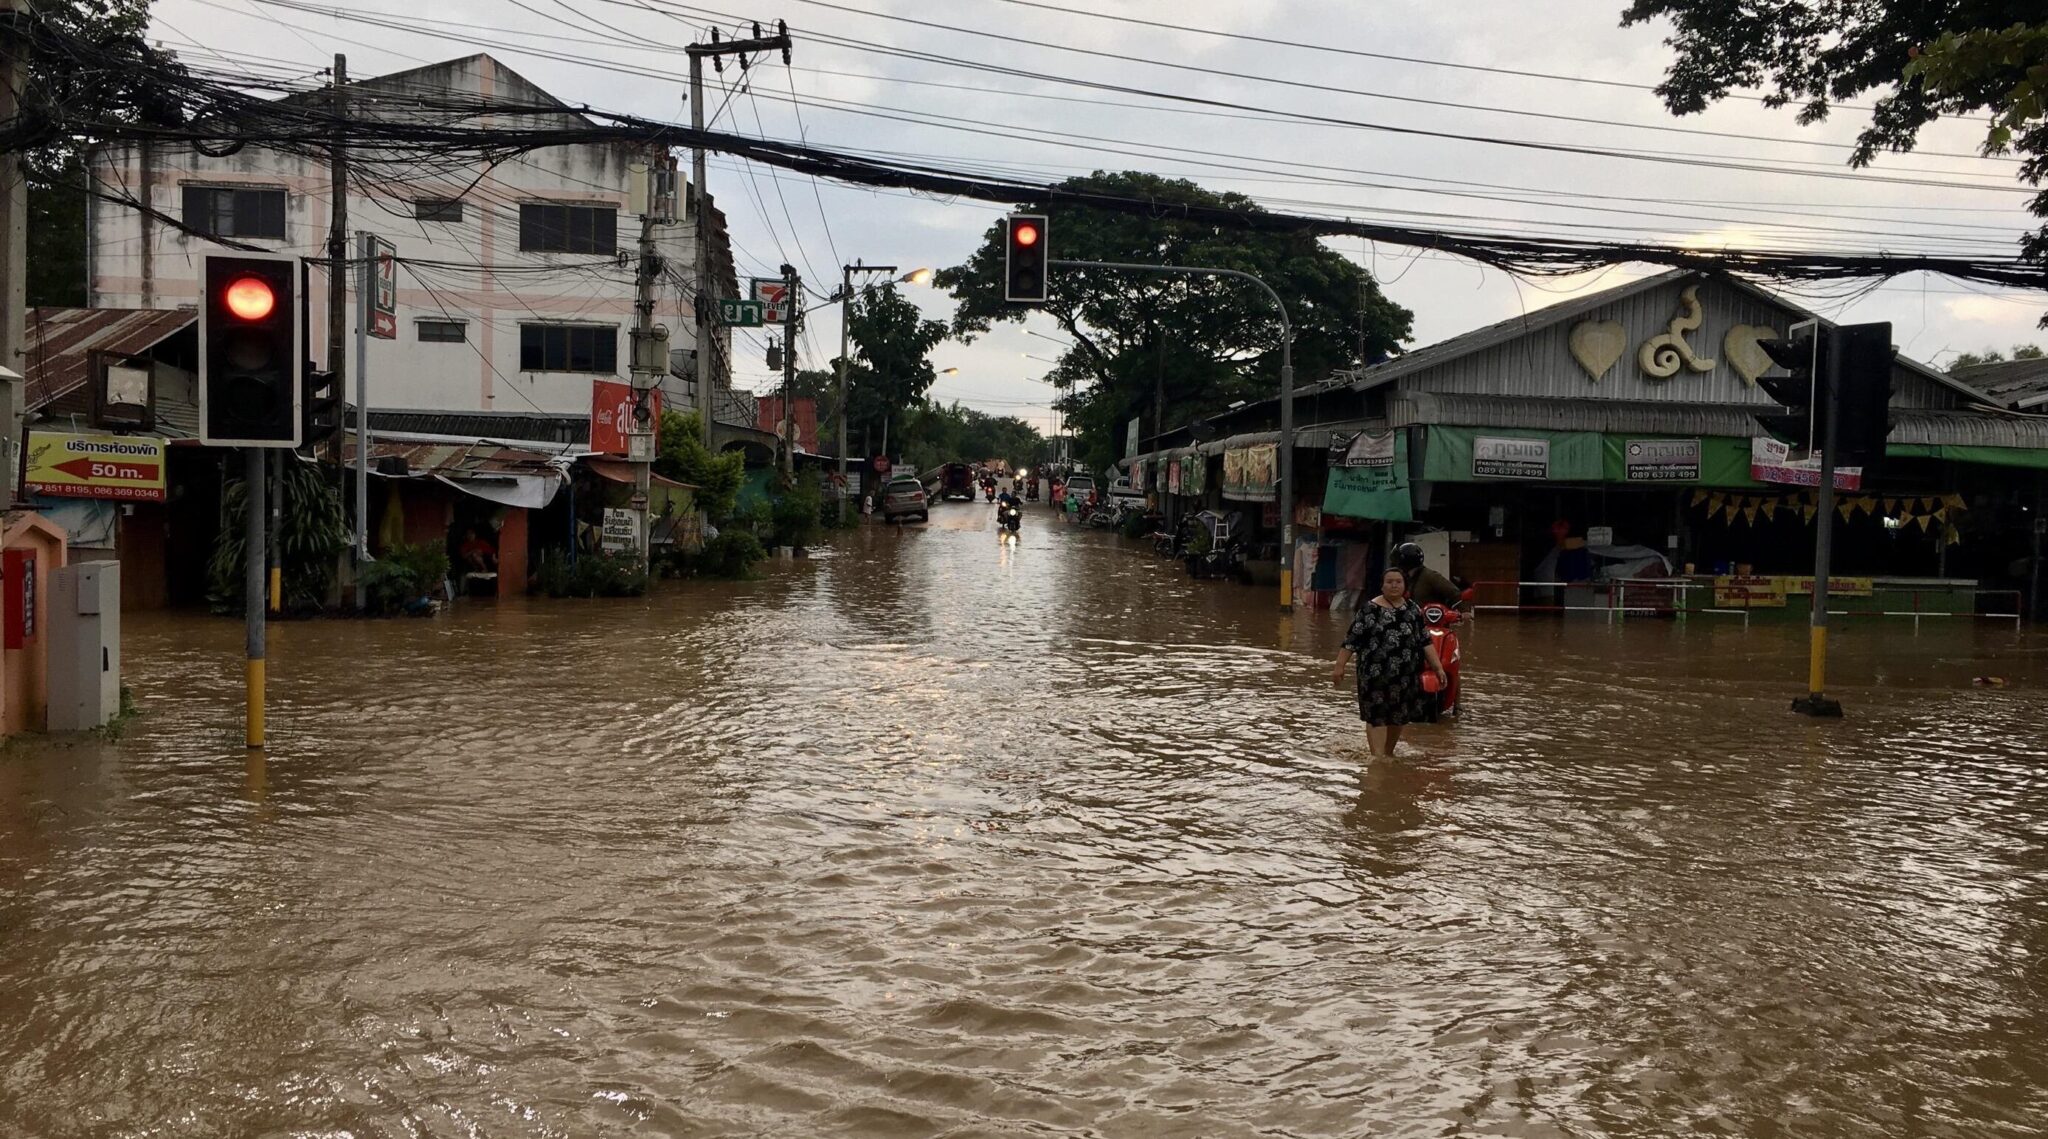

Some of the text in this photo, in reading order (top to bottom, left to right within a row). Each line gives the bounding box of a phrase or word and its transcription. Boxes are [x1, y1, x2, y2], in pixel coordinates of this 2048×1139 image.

[724, 304, 759, 323] ยา
[66, 440, 158, 456] บริการห้องพัก
[92, 464, 143, 478] 50 m.
[1477, 466, 1496, 474] 089
[1631, 471, 1650, 479] 089
[44, 484, 62, 492] 851
